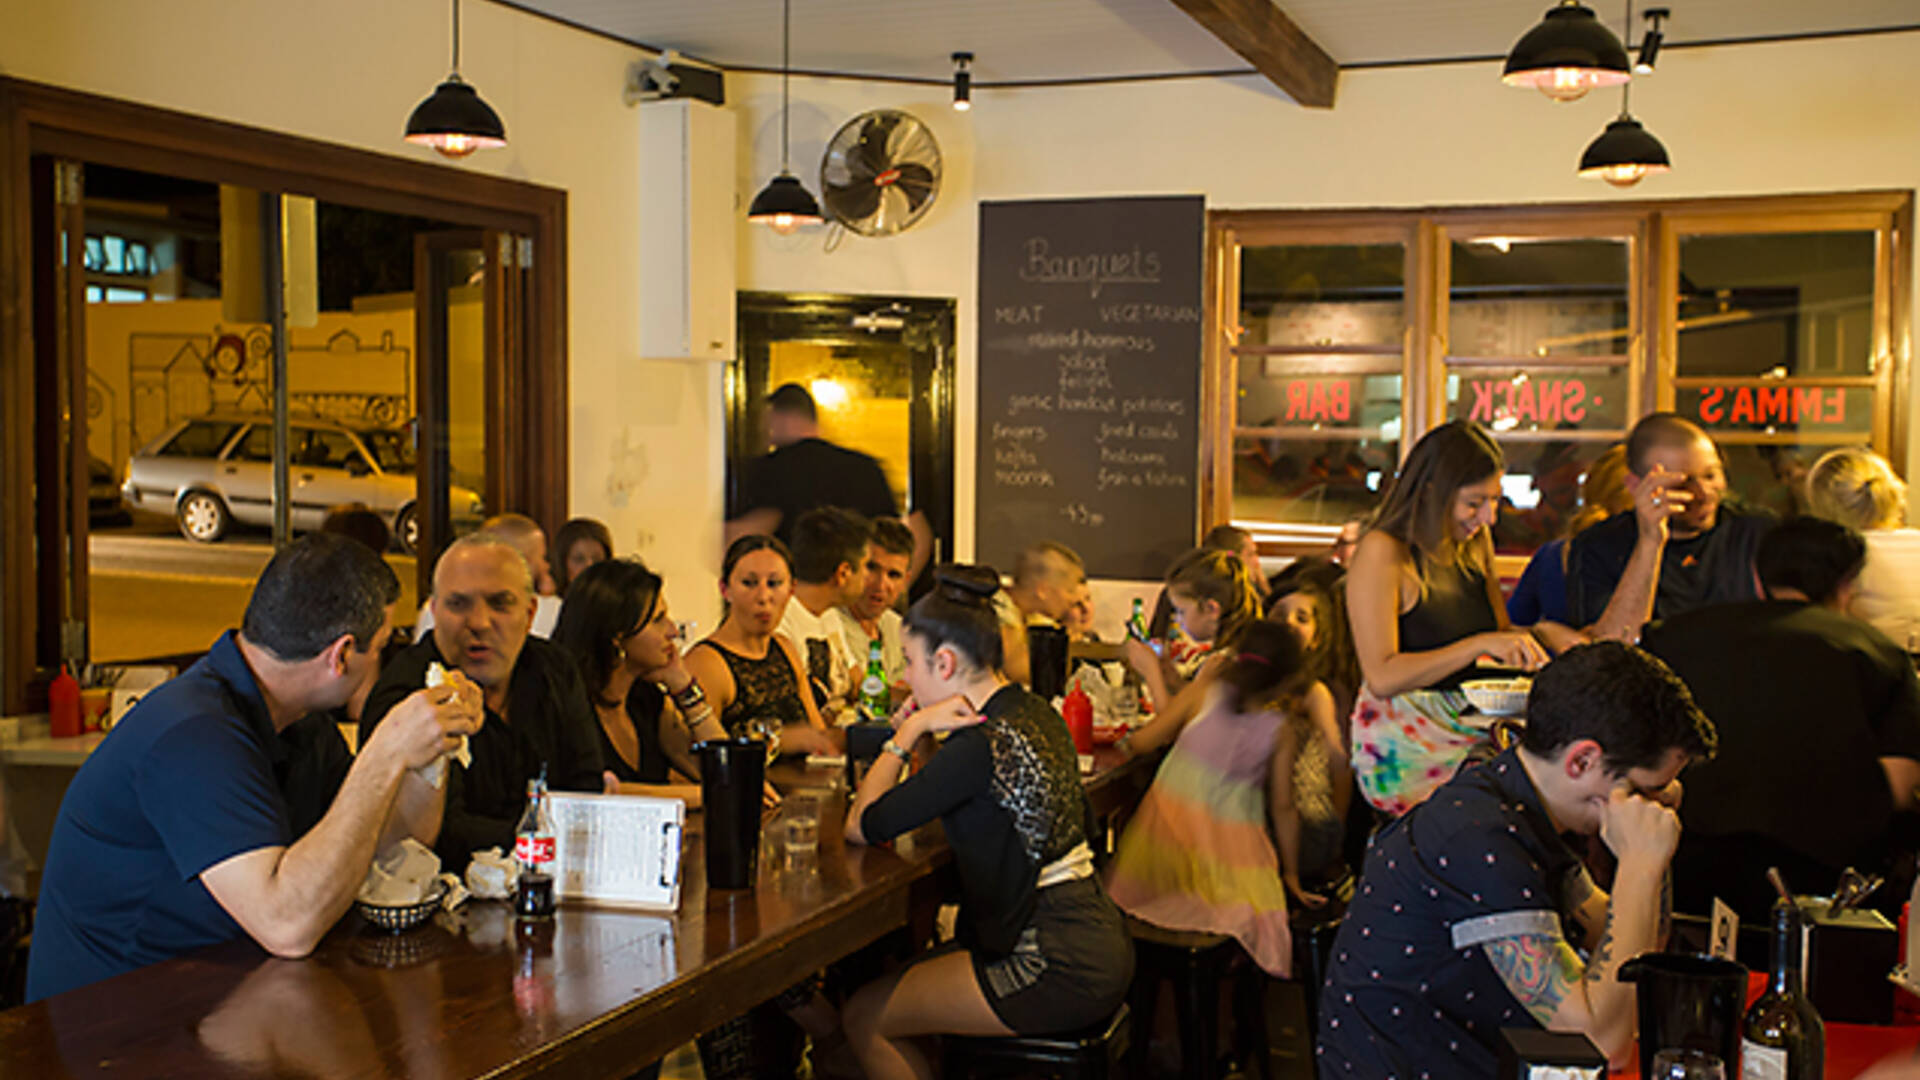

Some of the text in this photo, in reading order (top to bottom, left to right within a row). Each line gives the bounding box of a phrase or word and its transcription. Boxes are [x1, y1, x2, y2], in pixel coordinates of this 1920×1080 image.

[1019, 237, 1161, 299] Banquets
[994, 304, 1044, 324] MEAT
[1099, 303, 1200, 323] VEGETARIAN
